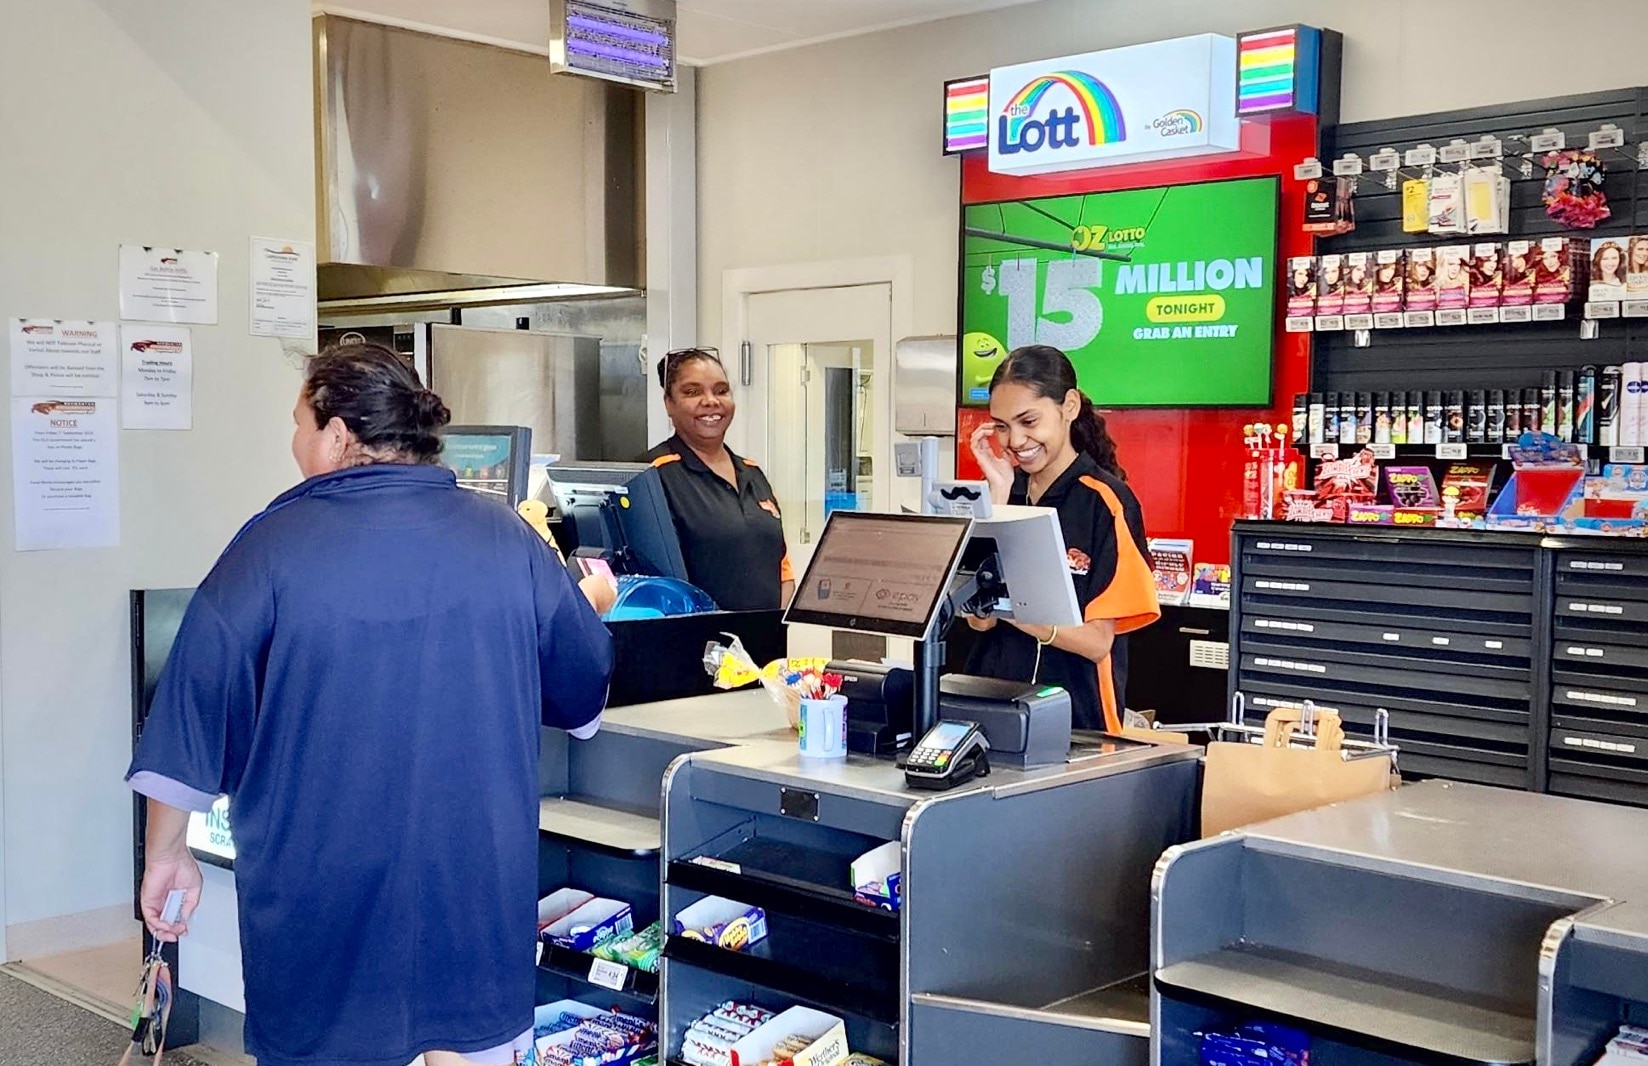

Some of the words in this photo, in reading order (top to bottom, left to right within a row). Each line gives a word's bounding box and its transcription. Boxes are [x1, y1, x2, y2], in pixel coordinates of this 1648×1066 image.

[1010, 103, 1028, 116] the
[998, 106, 1080, 155] Lott
[1153, 117, 1184, 129] Golden
[1160, 125, 1189, 137] Casket
[1072, 225, 1108, 251] OZ
[1108, 227, 1146, 243] LOTTO
[1115, 257, 1263, 295] MILLION
[1156, 302, 1216, 316] TONIGHT
[61, 329, 98, 338] WARNING
[1133, 326, 1170, 340] GRAB
[1171, 325, 1191, 339] AN
[1194, 324, 1239, 338] ENTRY
[50, 419, 78, 427] NOTICE
[206, 808, 231, 831] INS
[210, 832, 231, 848] SCRA
